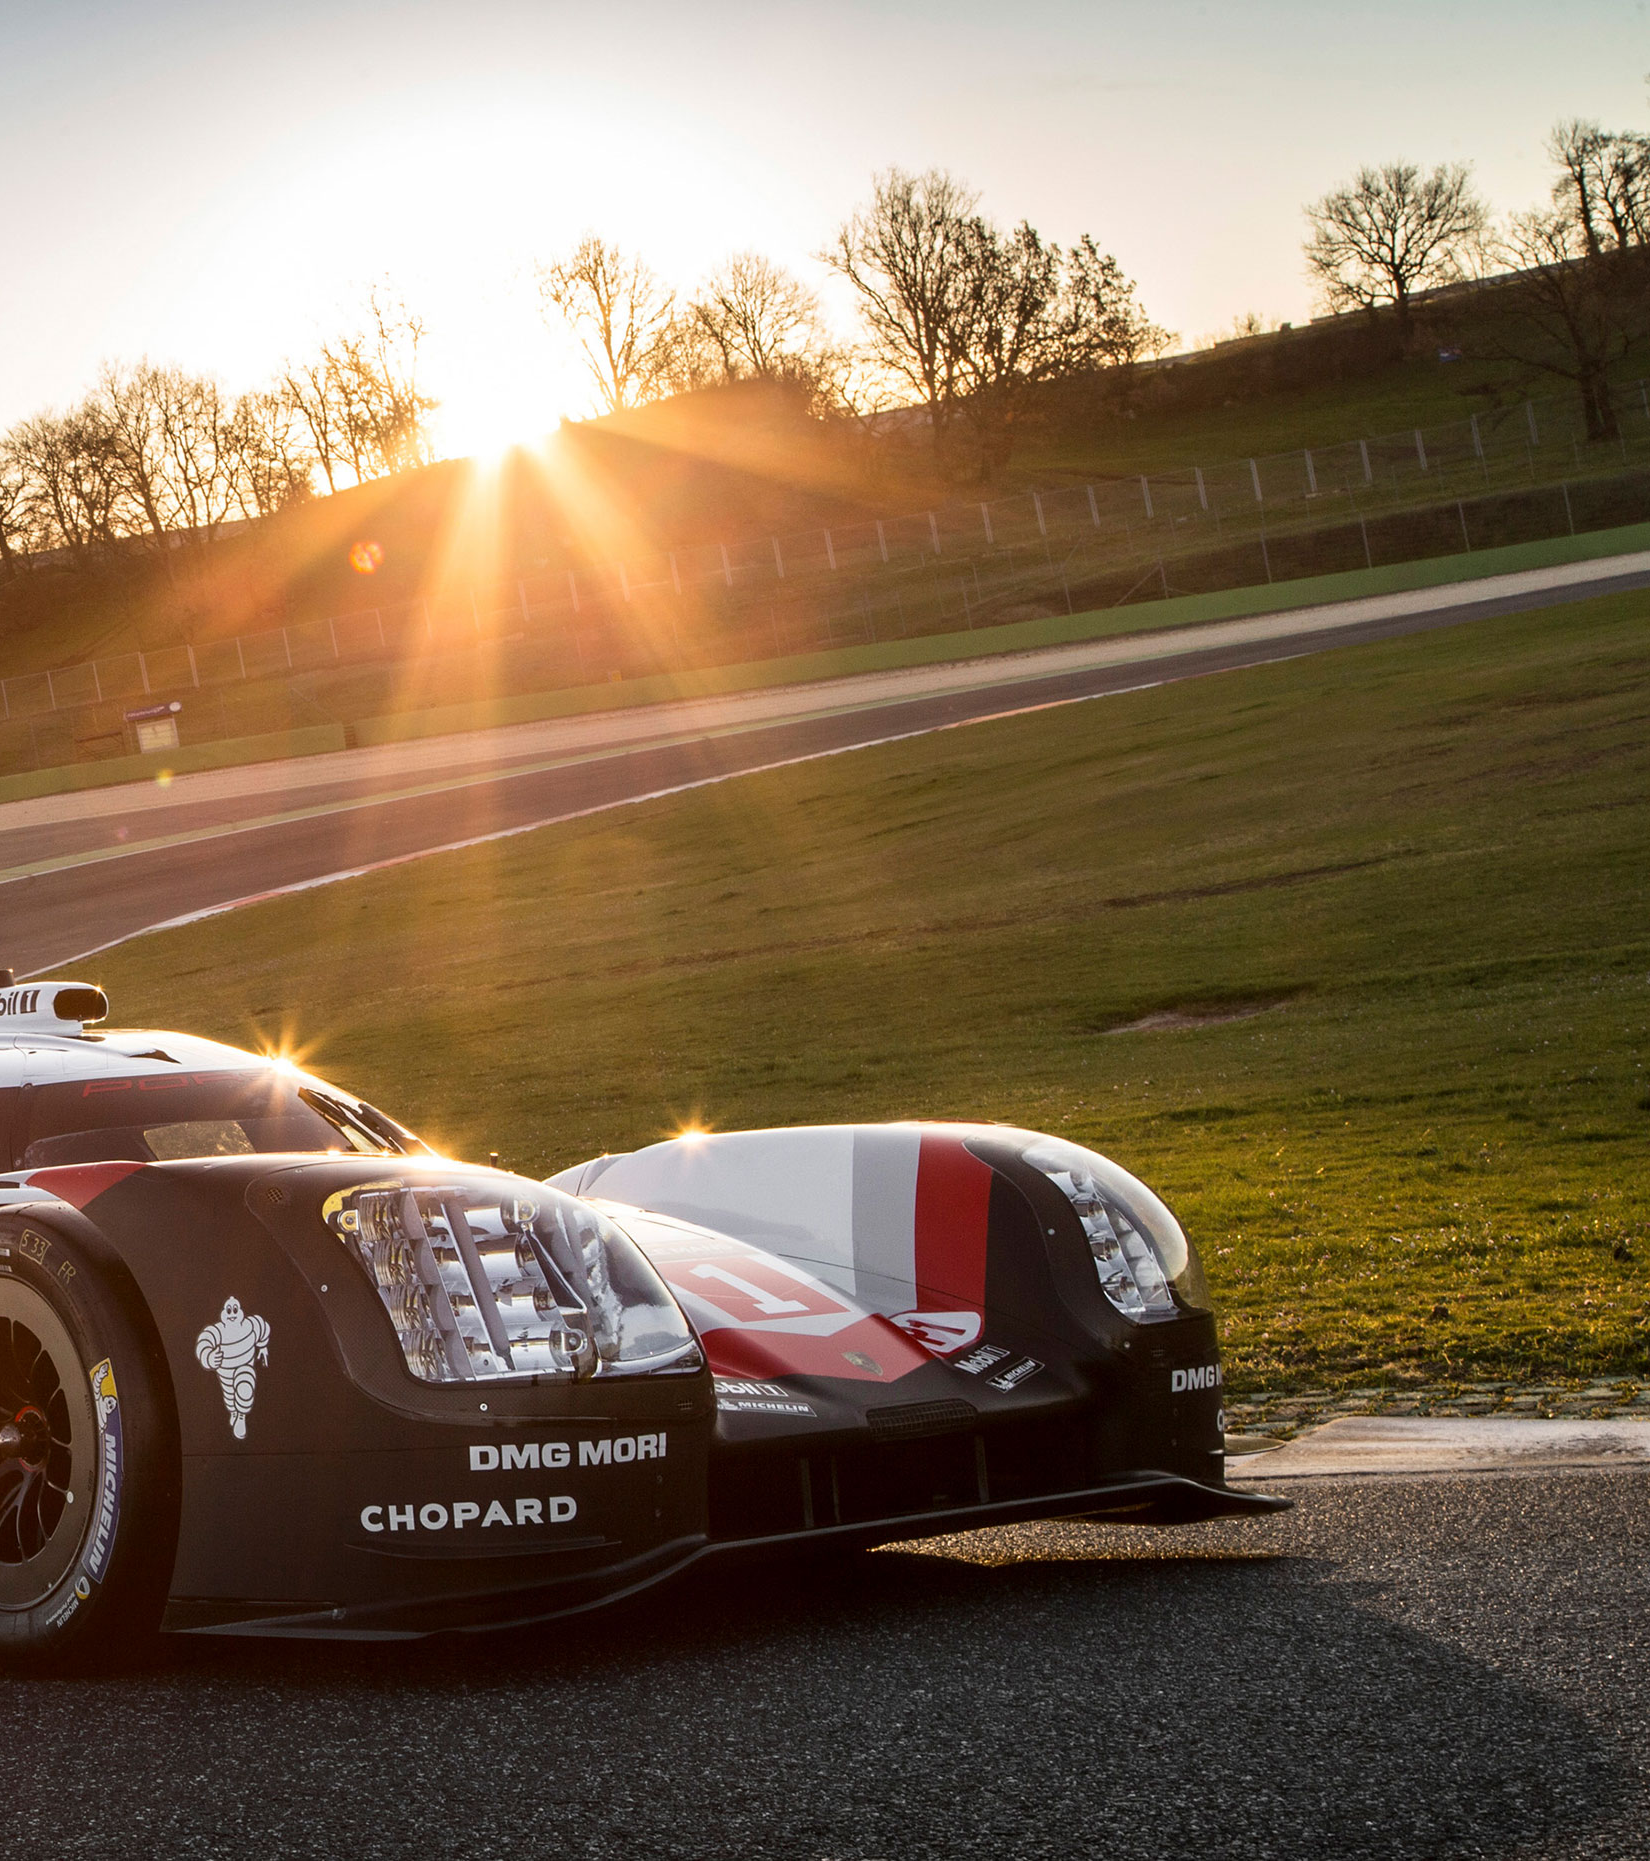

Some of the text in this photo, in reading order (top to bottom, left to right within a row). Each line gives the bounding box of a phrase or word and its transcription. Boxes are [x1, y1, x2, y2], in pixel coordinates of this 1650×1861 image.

[20, 989, 41, 1014] 1
[82, 1071, 276, 1098] PORS
[689, 1263, 810, 1314] 1
[954, 1350, 1001, 1375] Mobil
[1005, 1359, 1037, 1380] MICHELIN
[715, 1382, 762, 1395] obil
[1171, 1365, 1216, 1393] DMG
[738, 1401, 809, 1412] MICHELIN
[469, 1432, 667, 1471] DMG MORI
[89, 1433, 117, 1574] MICHELIN
[360, 1495, 578, 1532] CHOPARD
